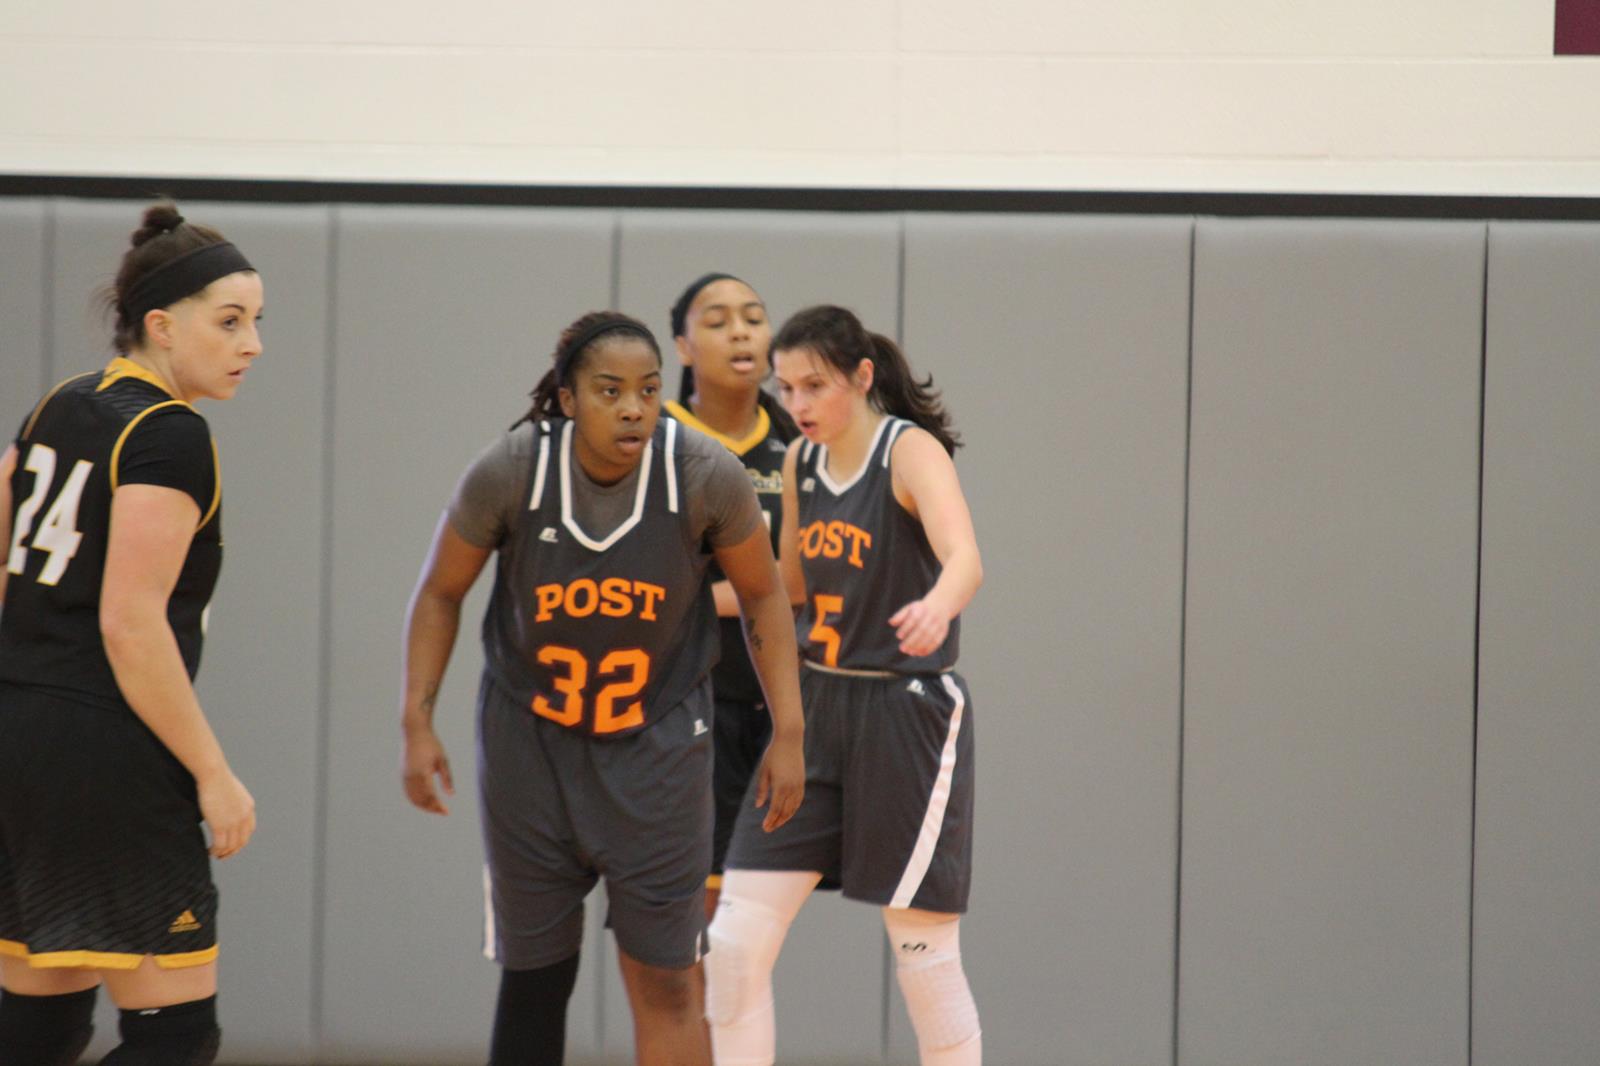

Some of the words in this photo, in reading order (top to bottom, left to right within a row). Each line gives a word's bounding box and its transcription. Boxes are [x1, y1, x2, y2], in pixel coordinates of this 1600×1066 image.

[6, 443, 94, 586] 24
[535, 577, 667, 623] POST
[808, 594, 844, 668] 5
[531, 645, 651, 734] 32
